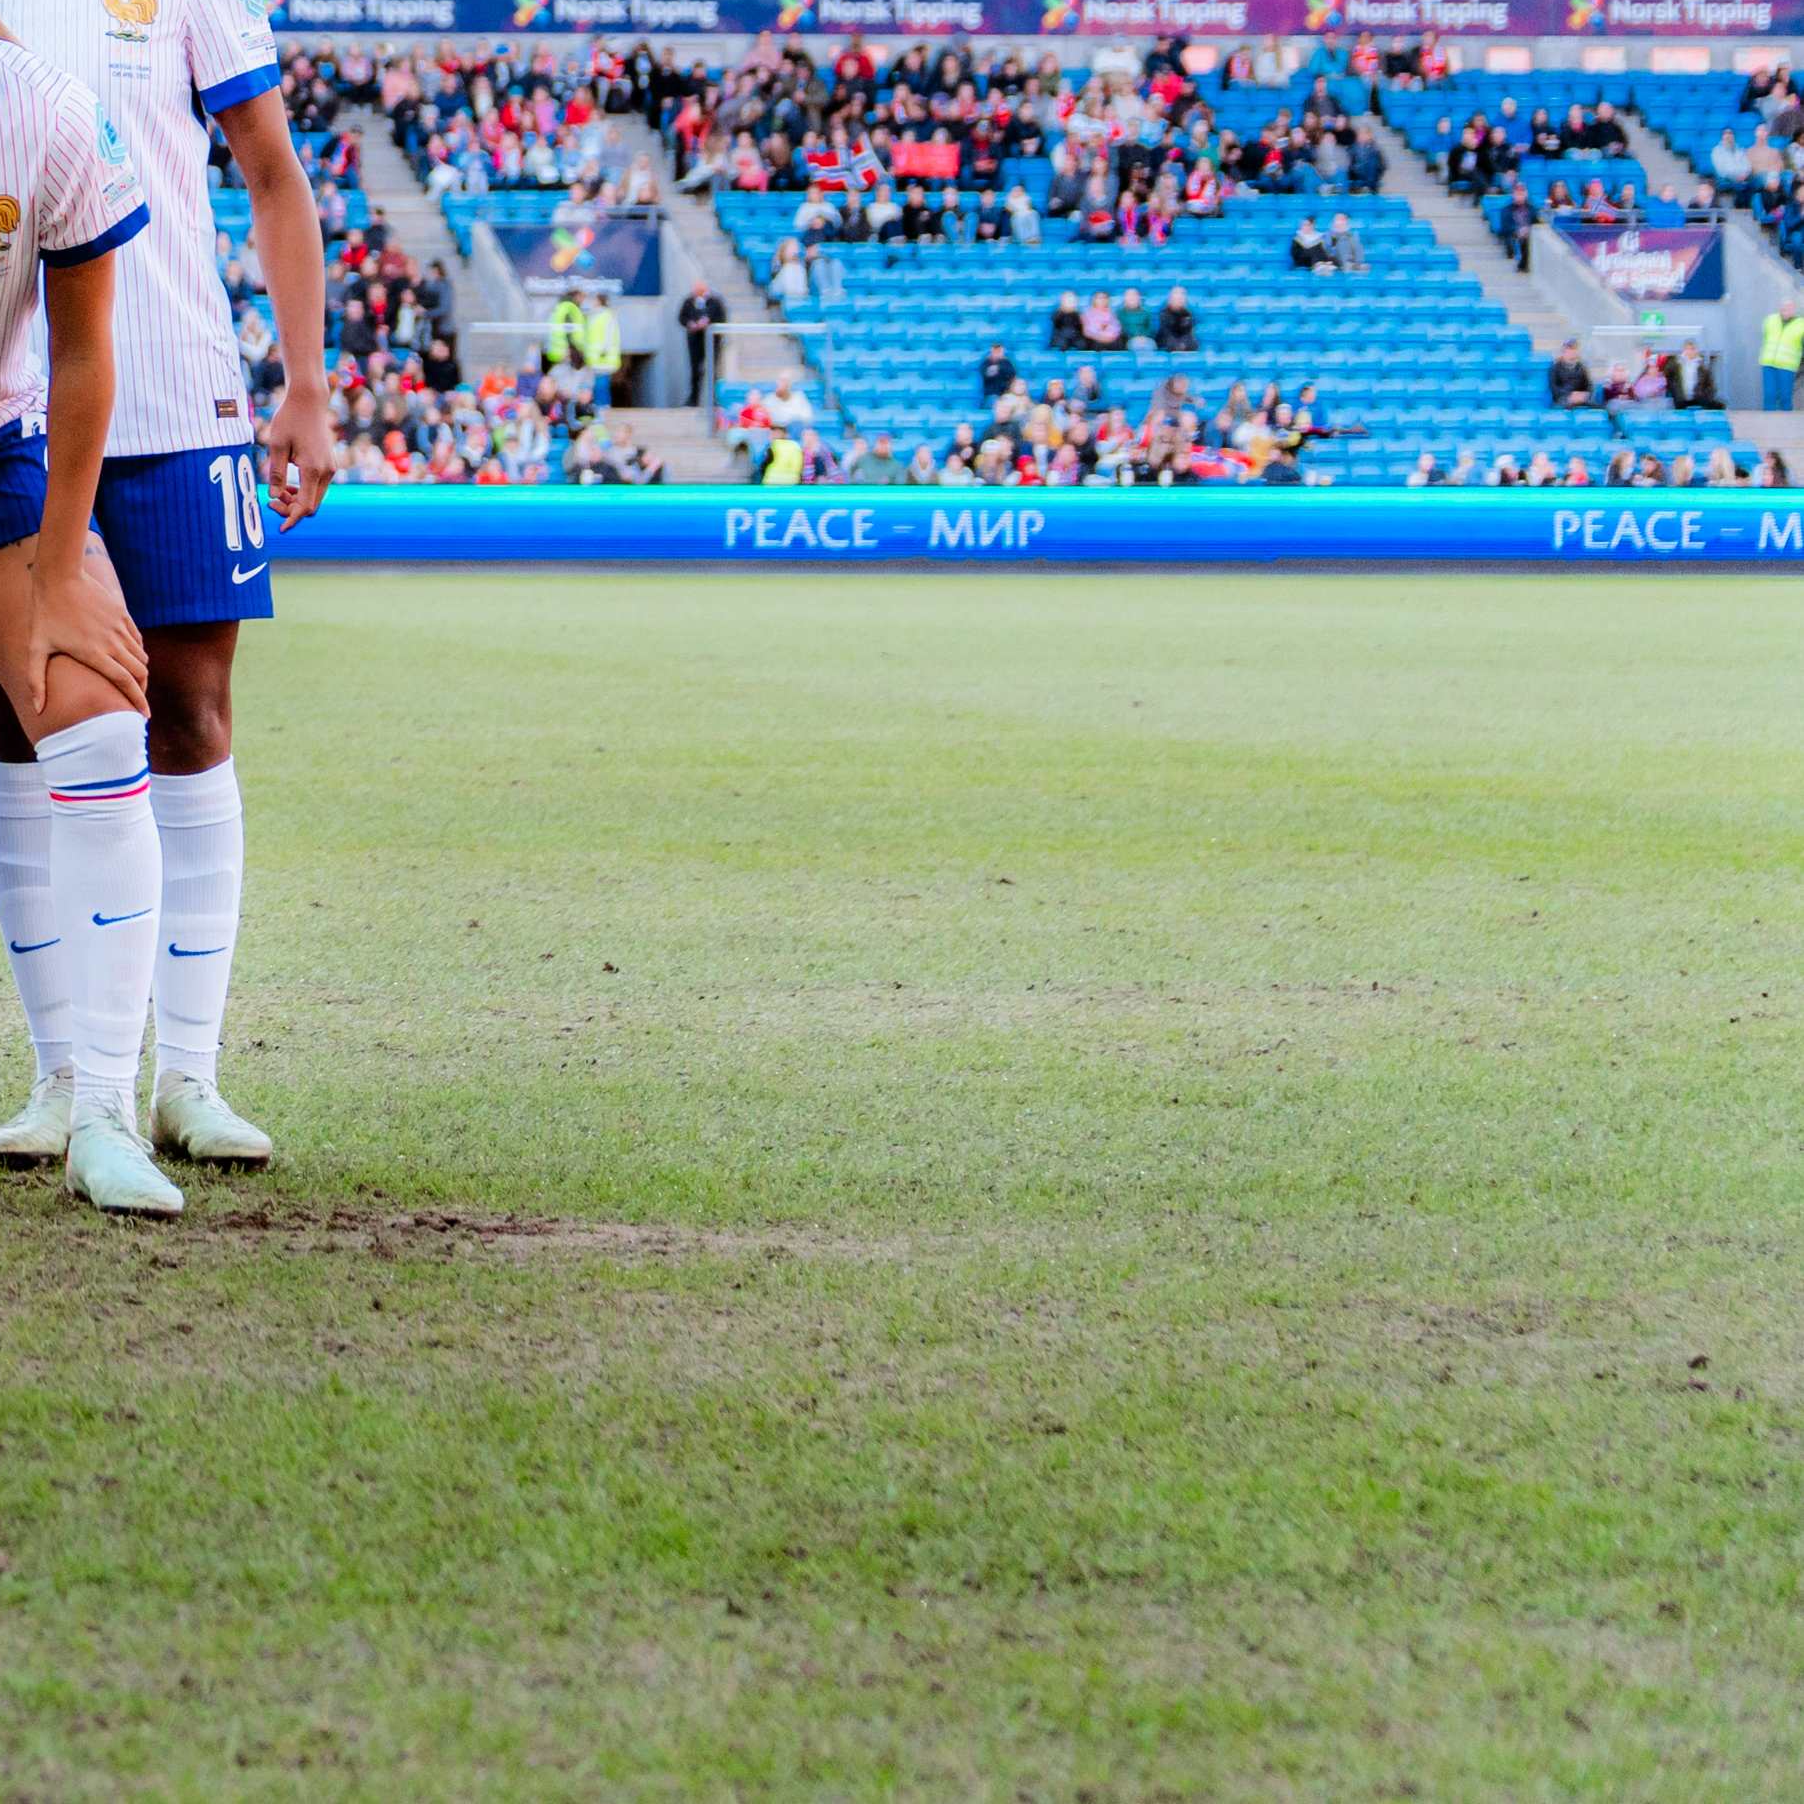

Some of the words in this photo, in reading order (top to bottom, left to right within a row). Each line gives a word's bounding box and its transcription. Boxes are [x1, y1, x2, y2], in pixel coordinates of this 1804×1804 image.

[208, 453, 265, 551] 18
[724, 508, 879, 550] PEACE
[928, 508, 1044, 550] МИР
[1553, 510, 1706, 552] PEACE
